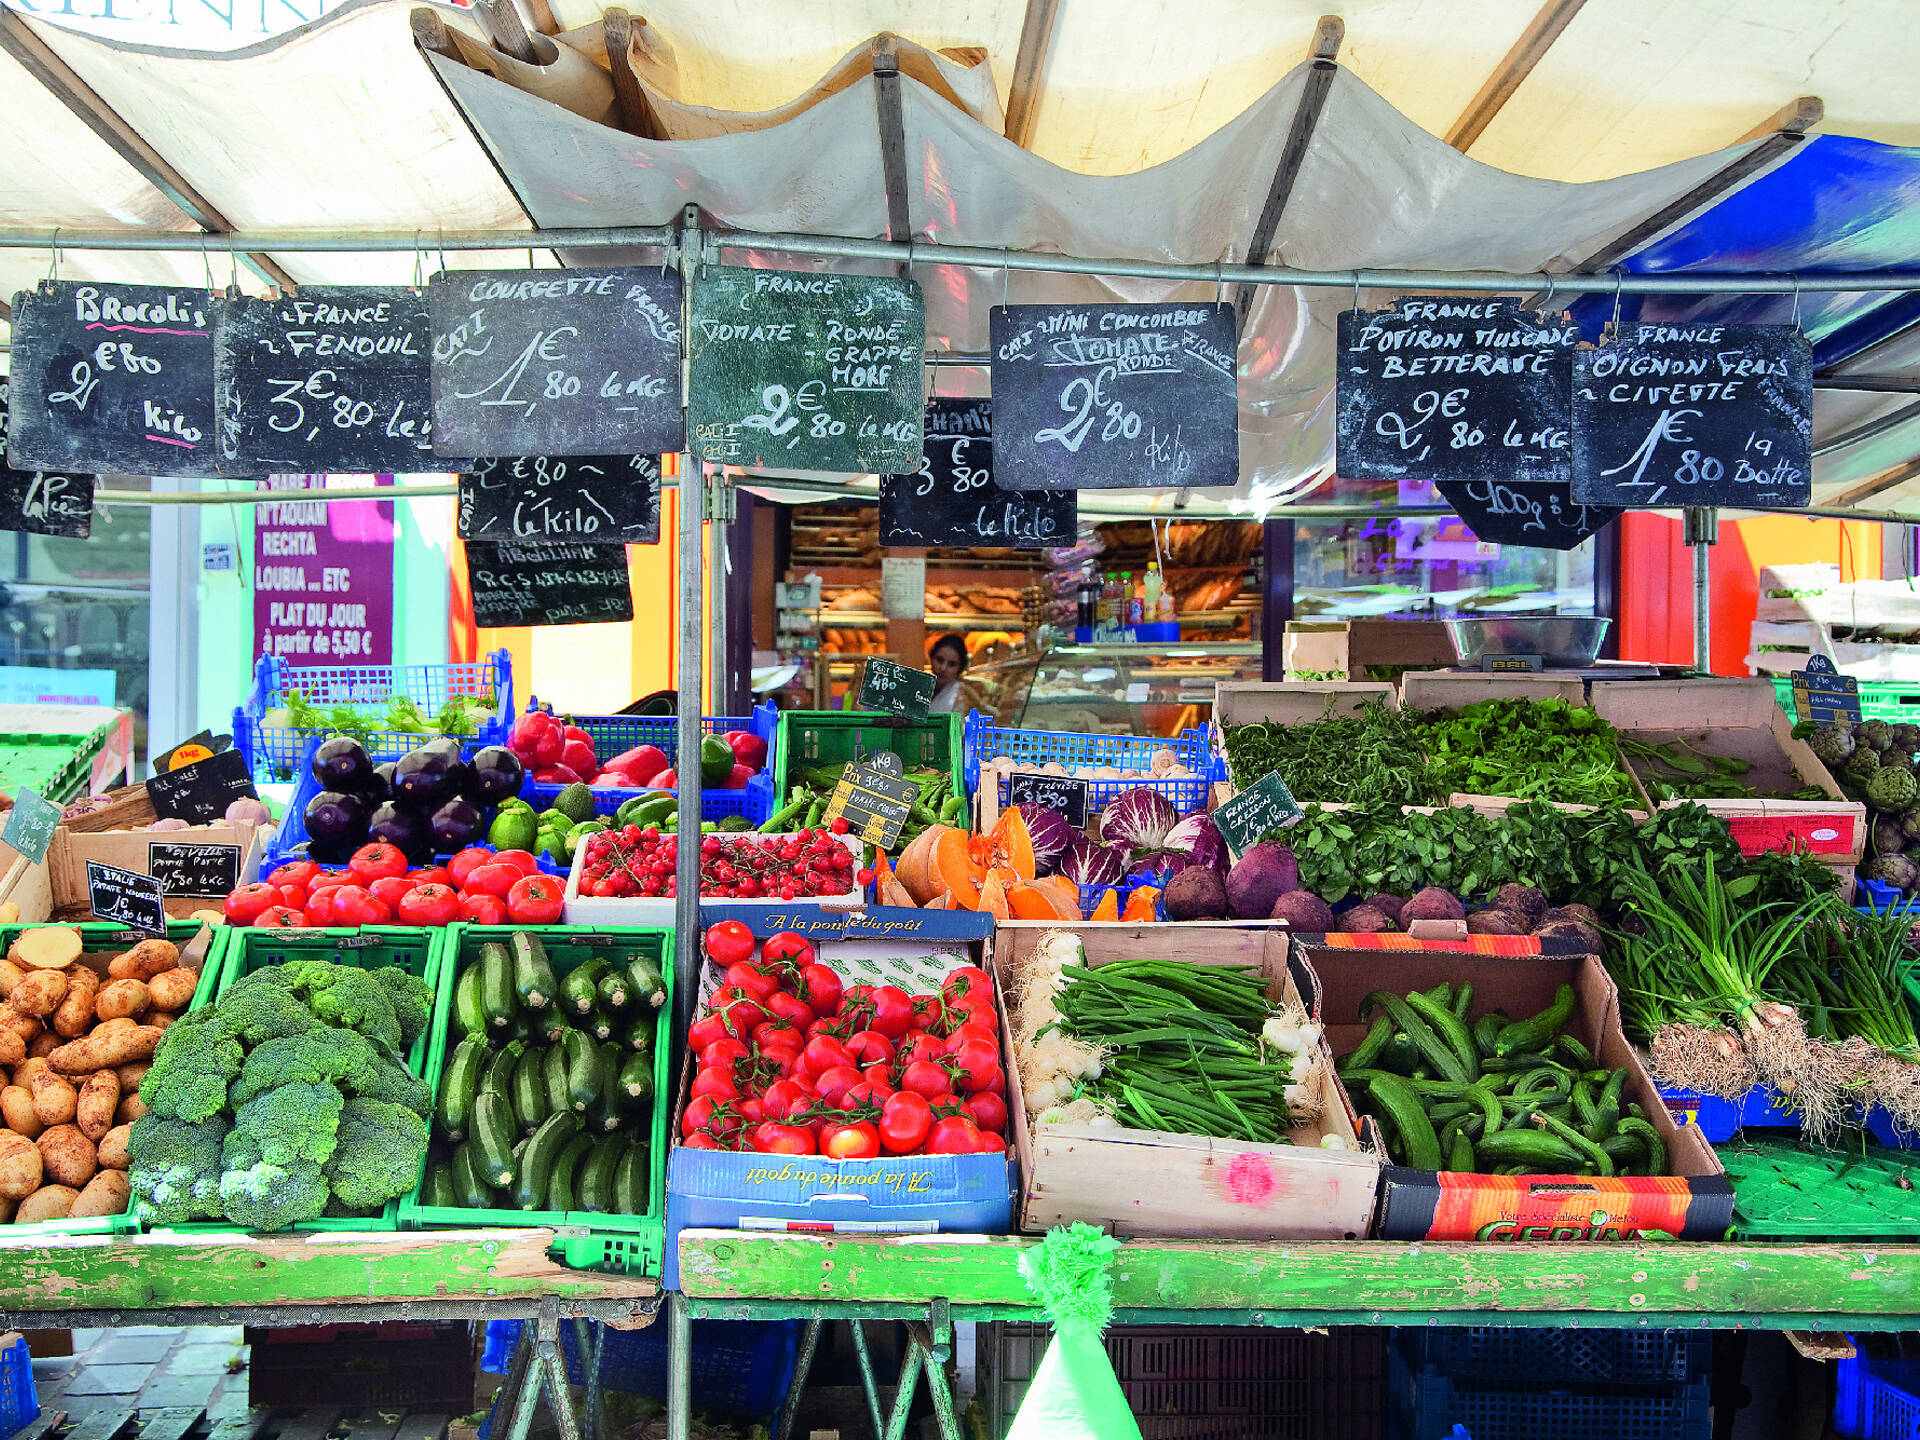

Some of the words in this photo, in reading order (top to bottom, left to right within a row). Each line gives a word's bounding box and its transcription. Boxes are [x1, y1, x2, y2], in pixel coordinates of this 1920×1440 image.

[469, 274, 620, 302] COURGETTE
[754, 274, 840, 296] FRANCE
[293, 302, 391, 325] FRANCE
[1099, 309, 1210, 332] CONCOMBRE
[1403, 302, 1503, 322] FRANCE
[826, 319, 907, 343] RONDE
[1637, 326, 1726, 345] FRANCE
[285, 331, 418, 358] FENOUIL
[1592, 347, 1708, 378] OIGNON
[1717, 350, 1789, 377] FRAIS
[261, 531, 318, 557] RECHTA
[269, 601, 306, 628] PLAT
[306, 602, 327, 628] DU
[327, 603, 367, 628] JOUR
[274, 628, 312, 658] partir
[312, 629, 331, 654] de
[765, 913, 785, 930] A
[788, 914, 807, 930] la
[861, 915, 882, 930] du
